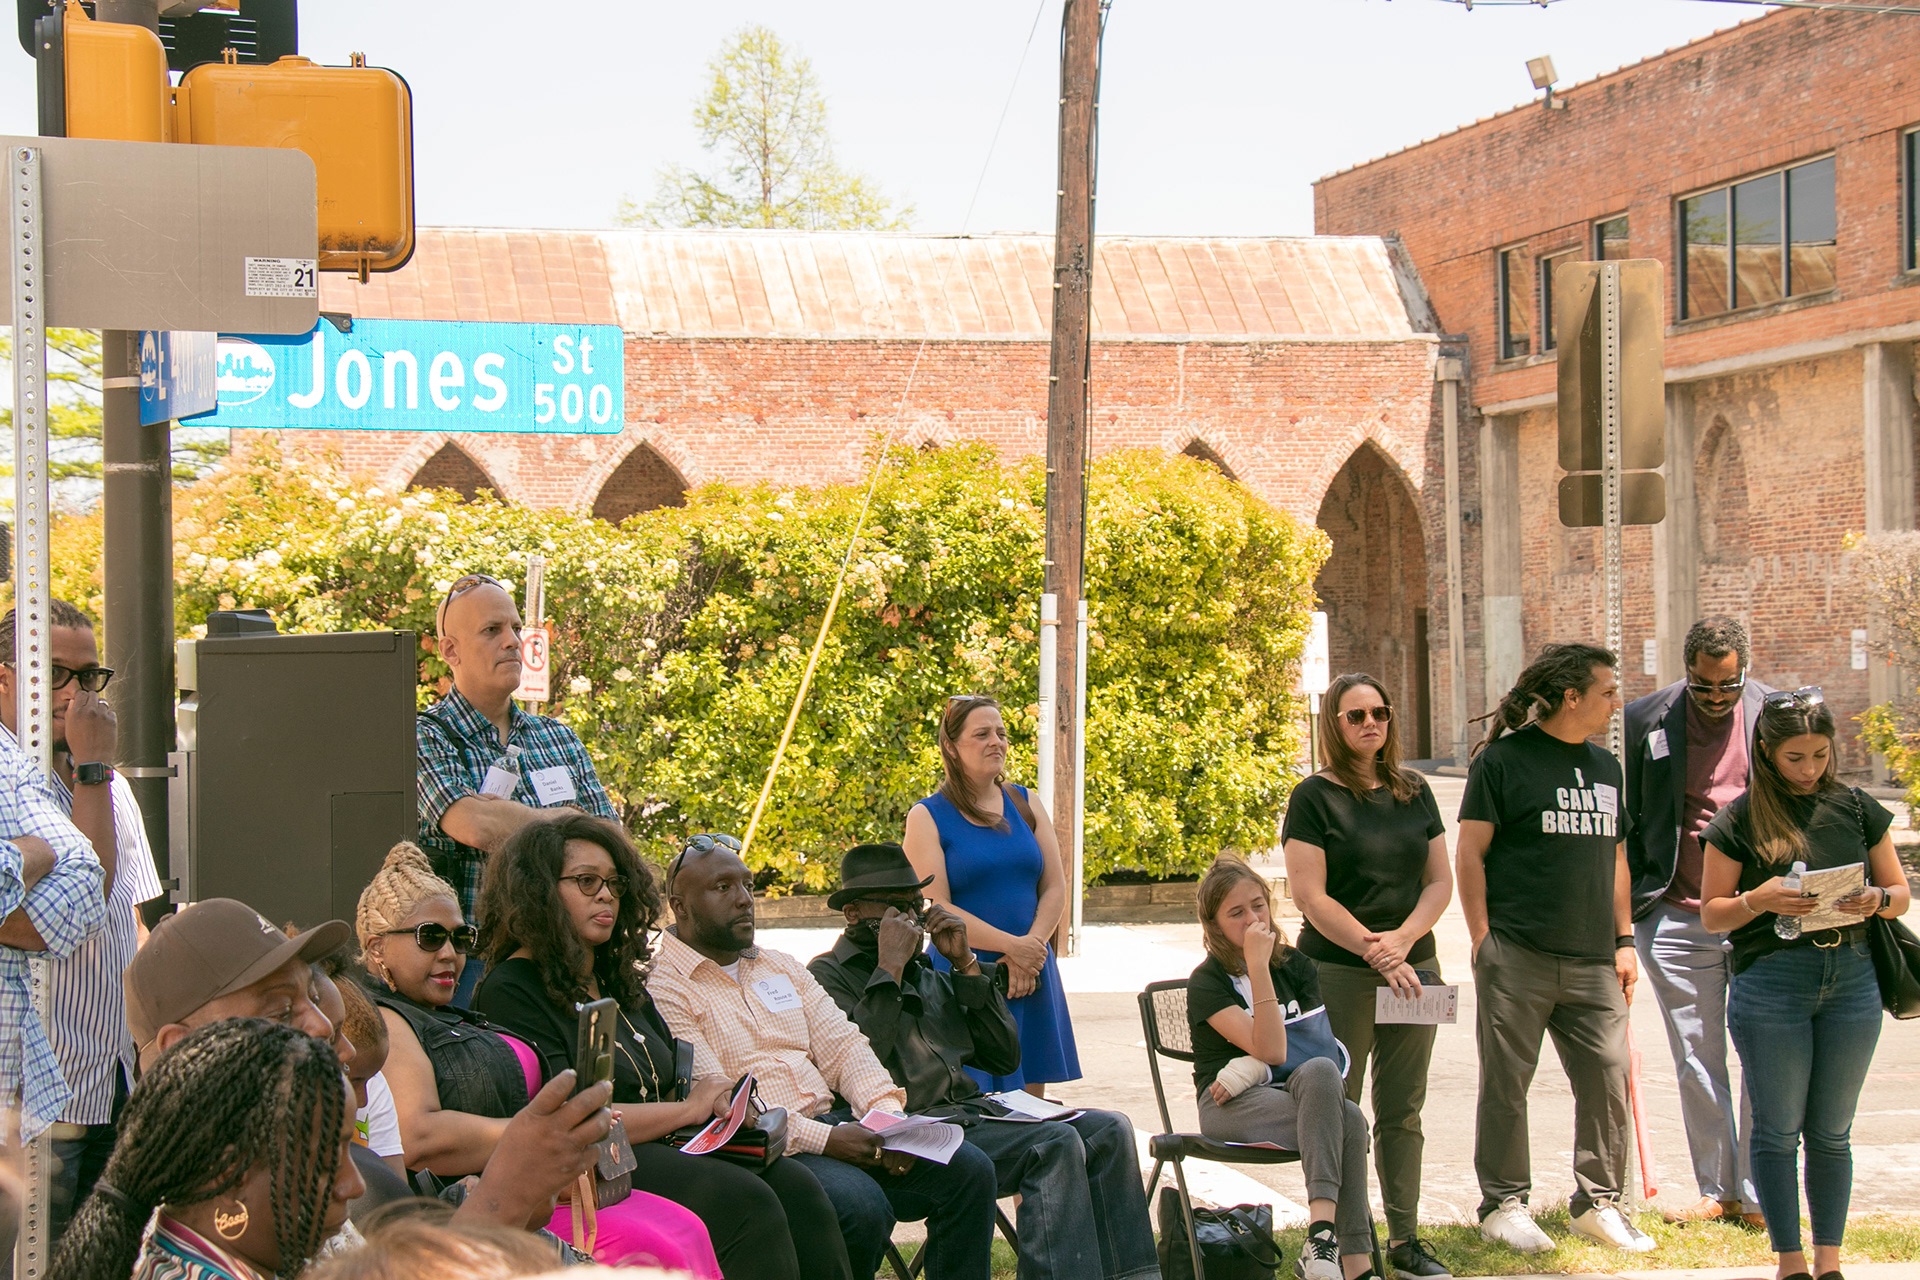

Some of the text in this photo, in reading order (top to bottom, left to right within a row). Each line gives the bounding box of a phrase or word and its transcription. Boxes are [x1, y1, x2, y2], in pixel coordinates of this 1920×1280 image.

[294, 268, 314, 287] 21
[197, 352, 213, 400] 300
[286, 331, 594, 412] Jones St
[534, 384, 613, 424] 500
[1574, 767, 1585, 788] I
[1556, 787, 1597, 811] CAN
